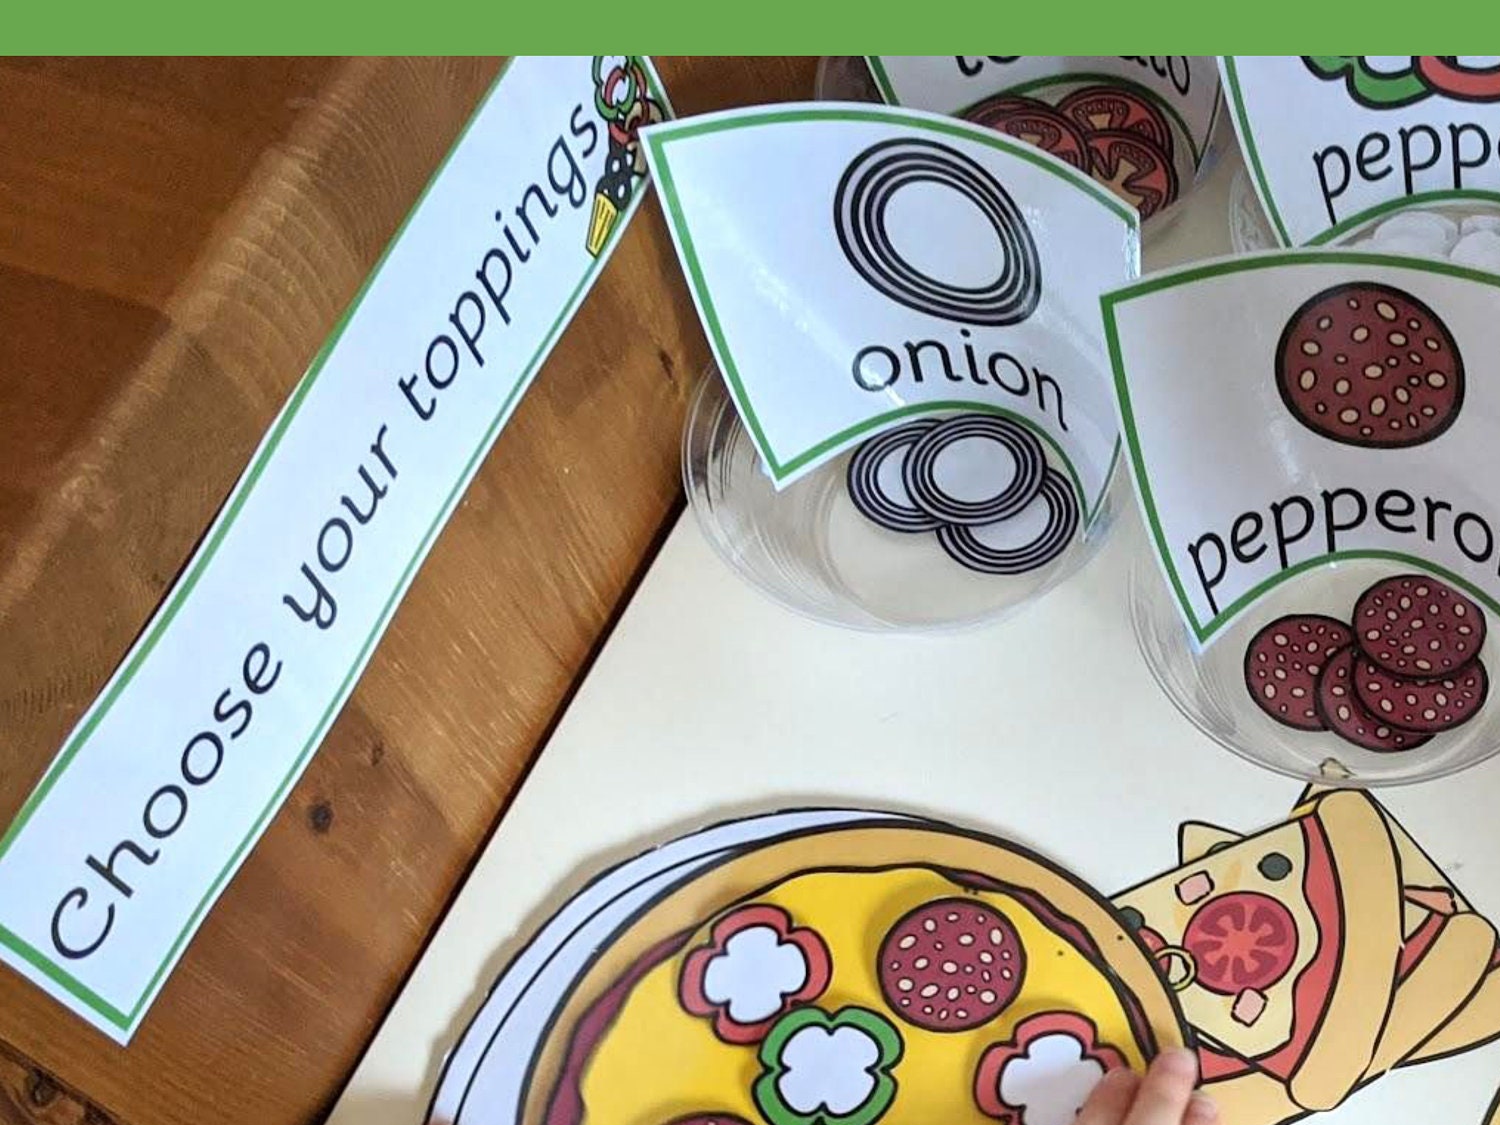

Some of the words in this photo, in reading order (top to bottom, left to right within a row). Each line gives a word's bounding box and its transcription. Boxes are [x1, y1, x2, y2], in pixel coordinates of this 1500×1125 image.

[51, 641, 282, 959] Choose
[284, 424, 399, 625] your
[399, 111, 597, 421] toppings
[853, 329, 1068, 431] onion
